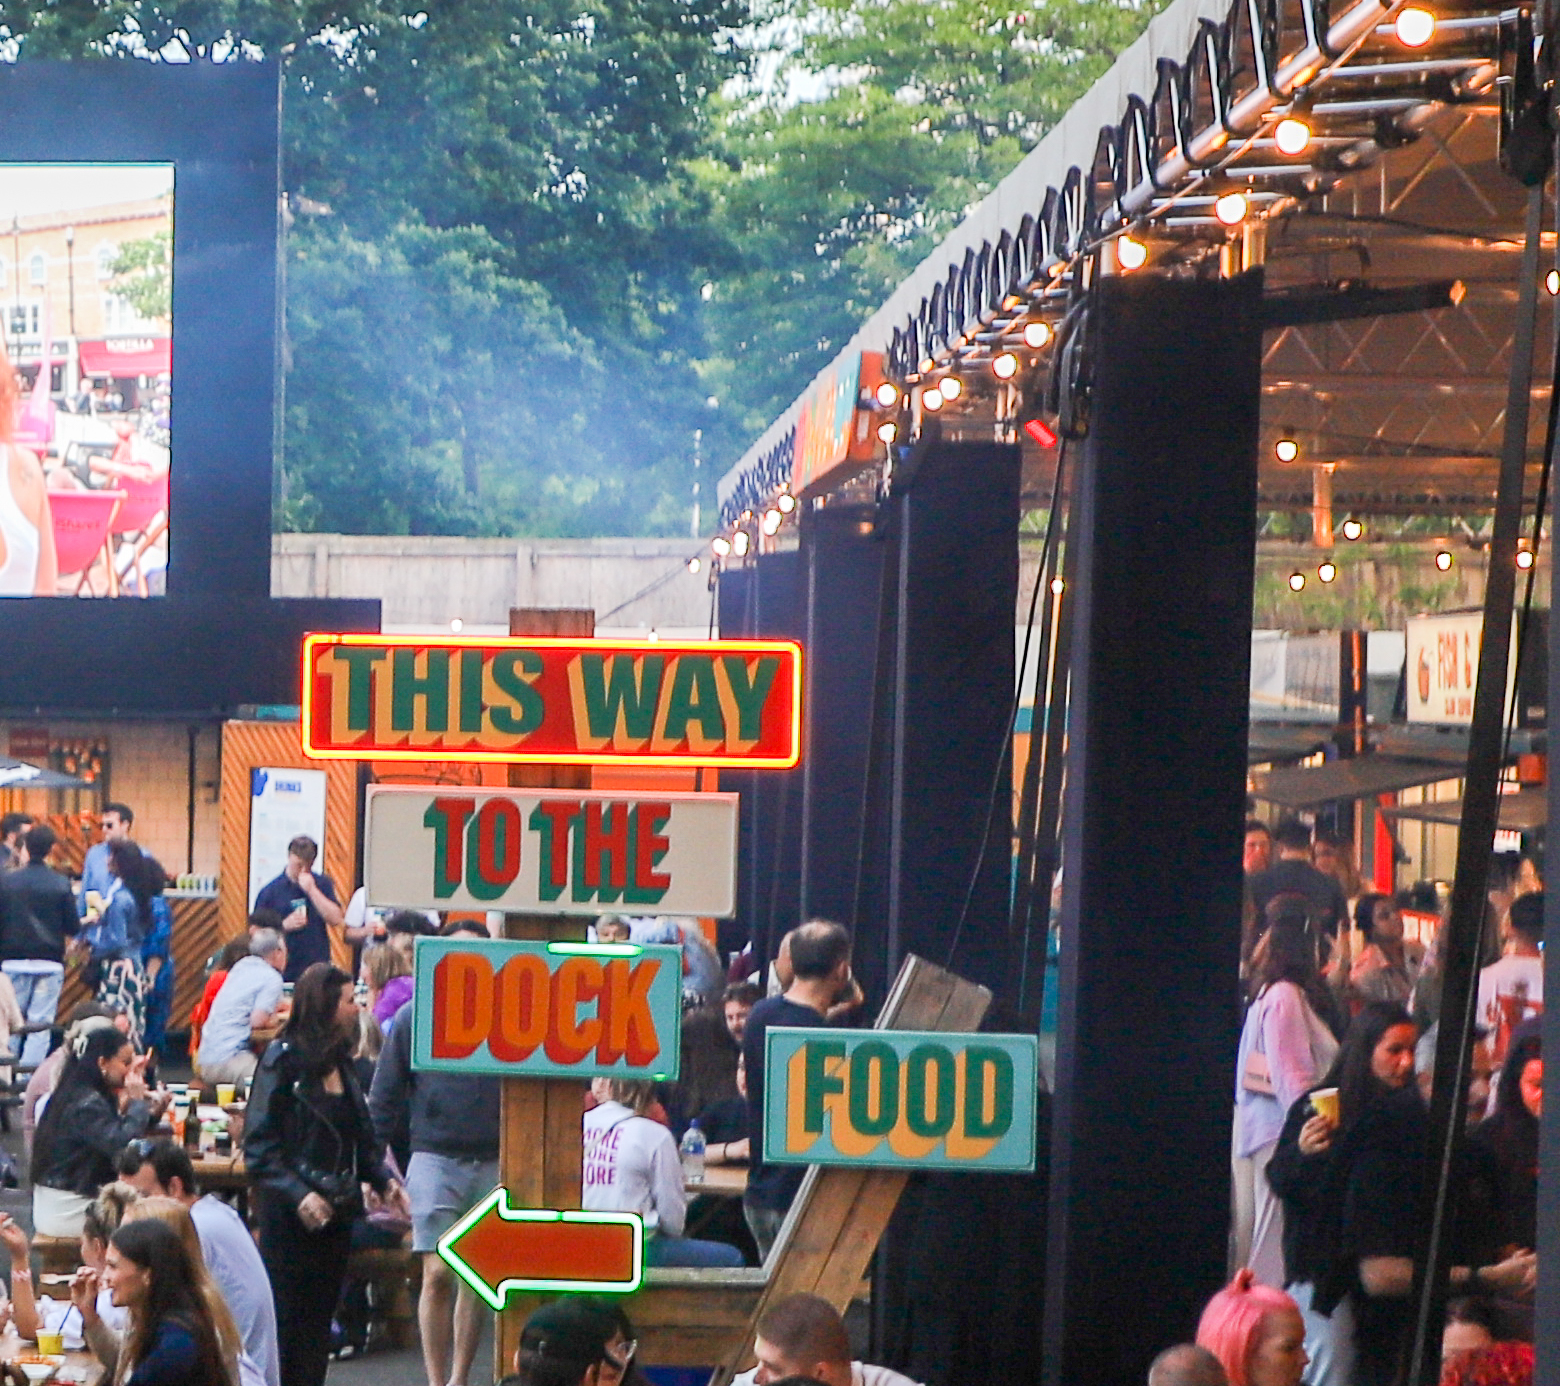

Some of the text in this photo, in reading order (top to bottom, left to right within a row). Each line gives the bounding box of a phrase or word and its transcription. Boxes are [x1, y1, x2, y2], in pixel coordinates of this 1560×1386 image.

[317, 646, 781, 753] THIS WAY
[423, 797, 671, 905] TO THE
[431, 952, 662, 1067] DOCK
[786, 1040, 1015, 1159] FOOD
